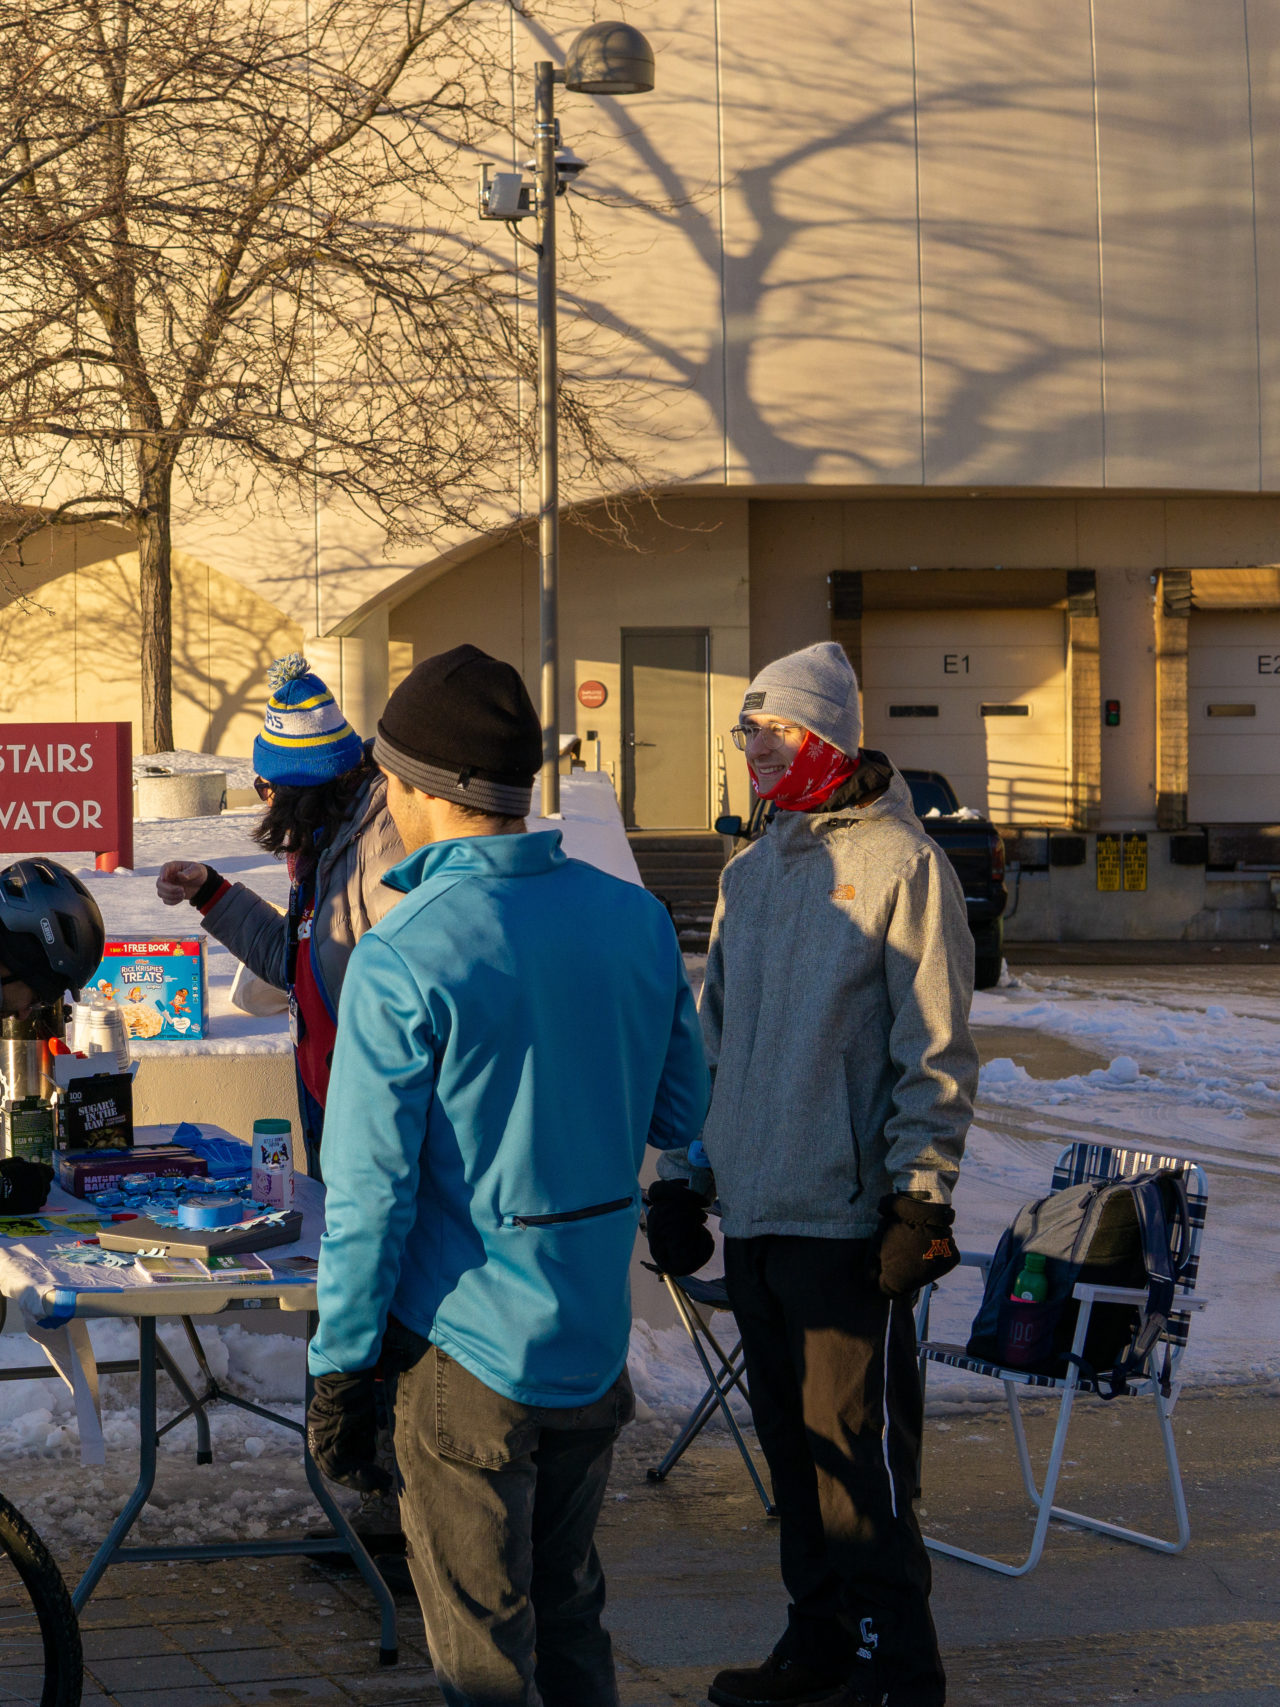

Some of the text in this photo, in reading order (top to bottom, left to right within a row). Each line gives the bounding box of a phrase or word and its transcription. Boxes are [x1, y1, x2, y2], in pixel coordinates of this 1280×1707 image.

[943, 654, 970, 674] E1
[128, 943, 148, 952] FREE
[148, 943, 170, 952] BOOK
[135, 965, 164, 973] KRISPIES
[123, 972, 163, 983] TREATS
[78, 1101, 109, 1116] SUGAR
[85, 1112, 97, 1122] IN
[97, 1107, 118, 1119] THE
[84, 1119, 105, 1131] RAW
